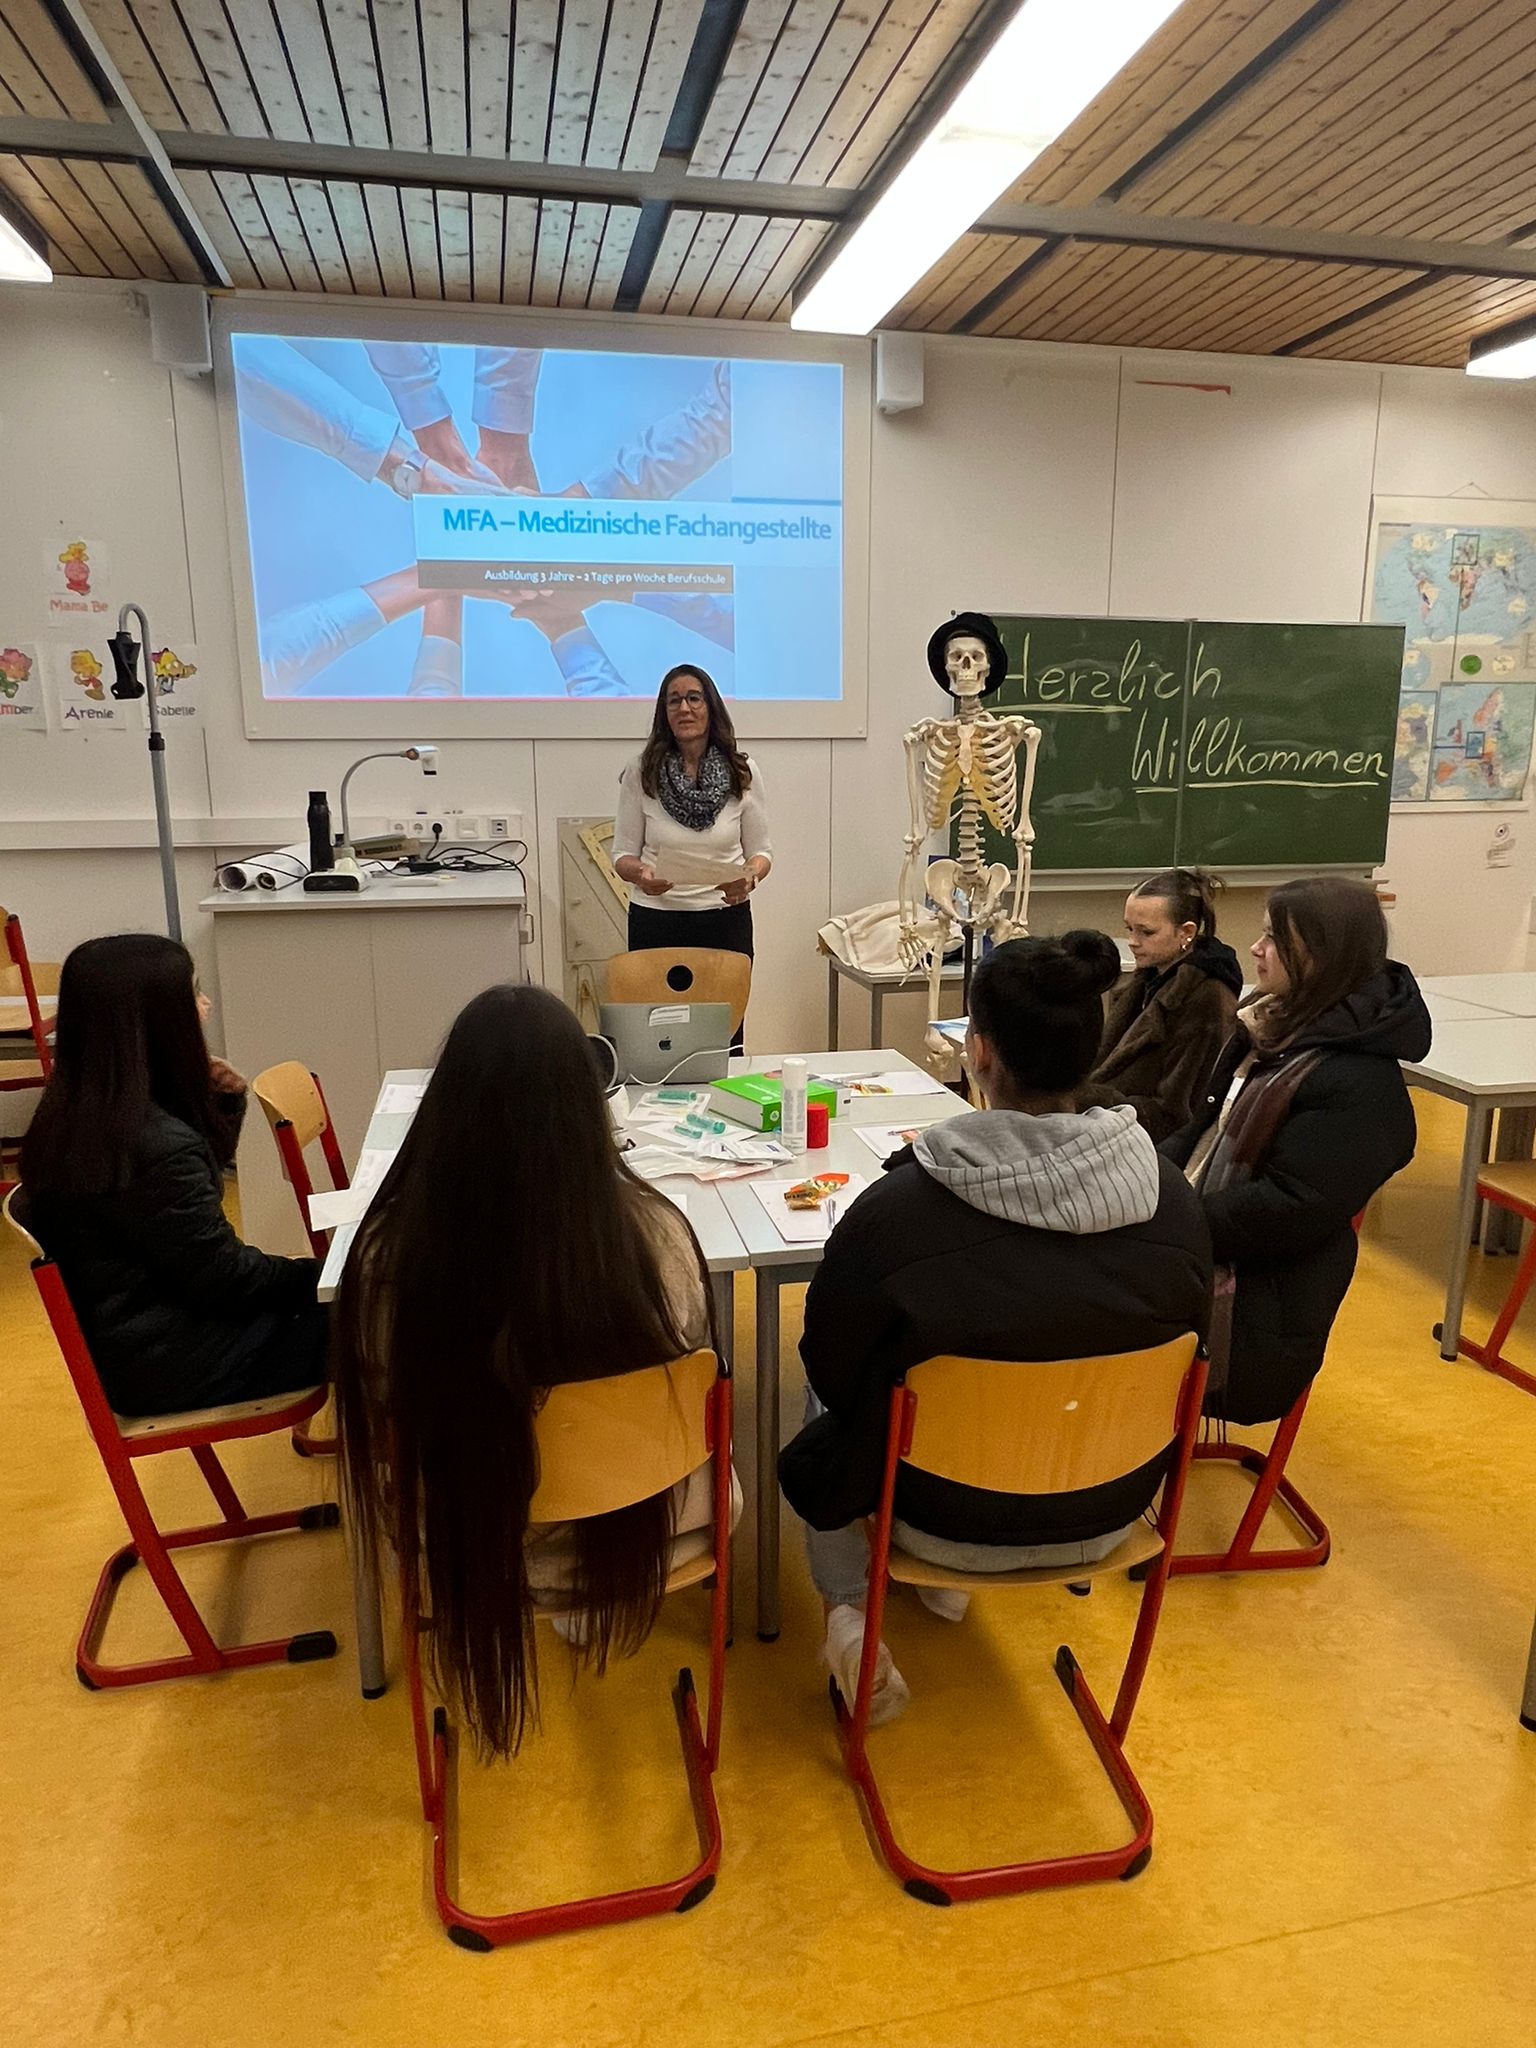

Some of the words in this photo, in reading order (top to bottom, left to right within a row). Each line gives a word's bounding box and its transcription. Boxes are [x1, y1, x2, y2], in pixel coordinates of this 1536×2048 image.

[443, 508, 498, 531] MFA
[518, 510, 661, 536] Medizinische
[665, 513, 832, 545] Fachangestellte
[484, 570, 539, 584] Ausbildung
[540, 573, 546, 582] 3
[549, 571, 574, 582] Jahre
[584, 574, 589, 582] 2
[592, 572, 613, 584] Tage
[616, 575, 632, 584] pro
[634, 573, 666, 584] Woche
[667, 573, 726, 585] Berufsschule
[997, 632, 1222, 703] Herzlich
[0, 704, 34, 715] mber
[1131, 708, 1388, 783] Willkommen
